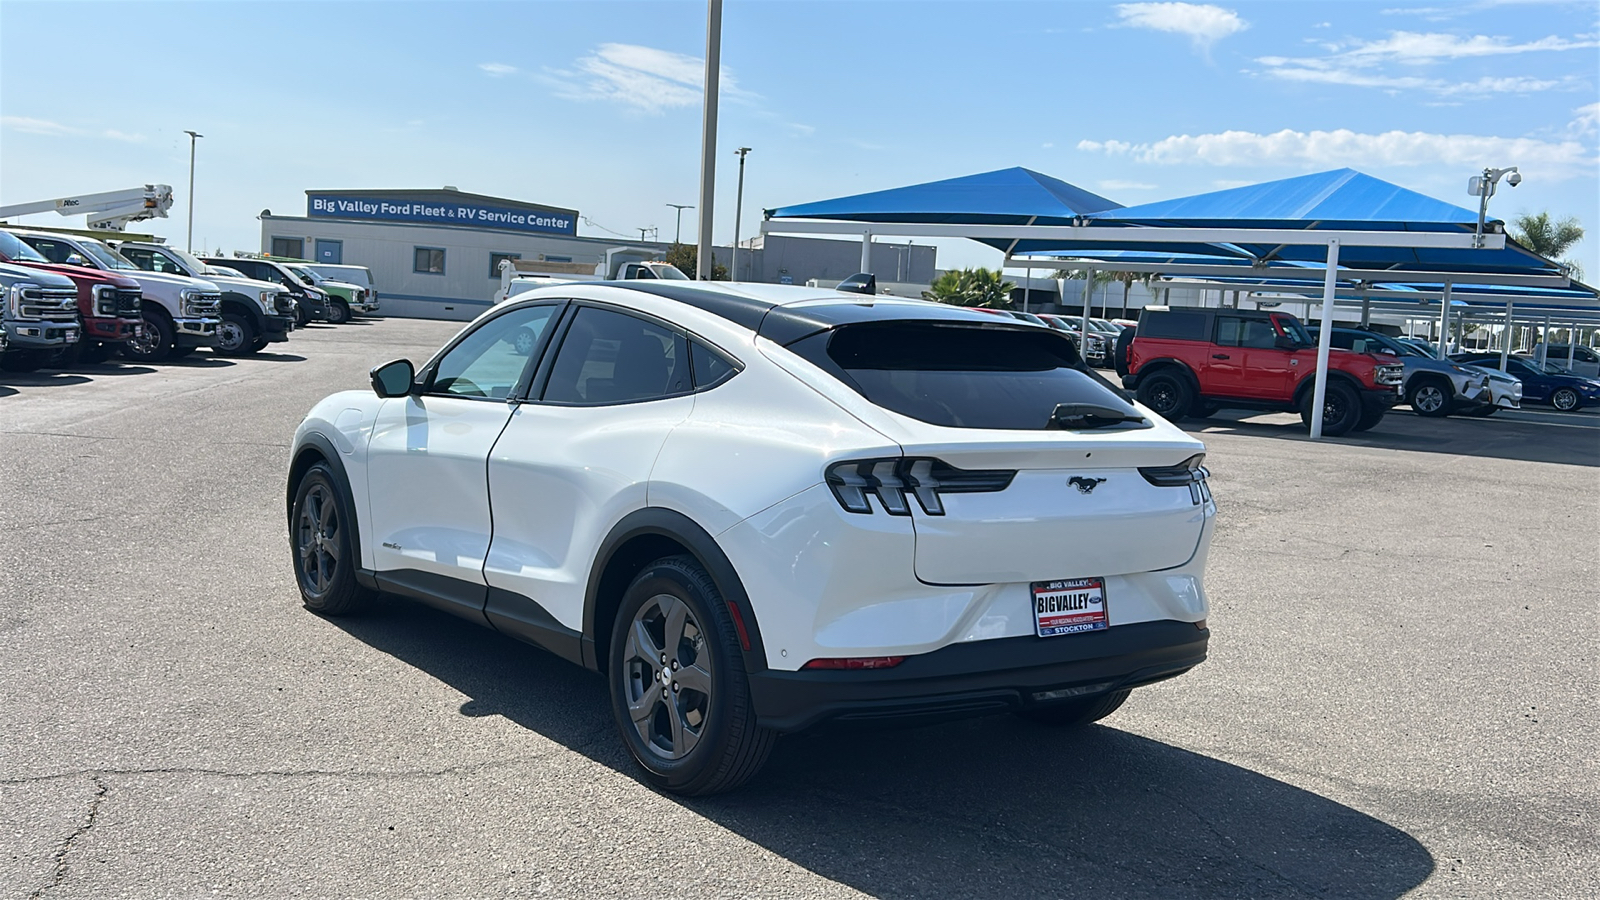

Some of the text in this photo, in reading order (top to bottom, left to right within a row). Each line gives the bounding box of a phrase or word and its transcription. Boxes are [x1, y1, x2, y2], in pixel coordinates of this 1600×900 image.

[313, 199, 569, 229] Big Valley Ford Fleet & RV Service Center
[1064, 579, 1088, 588] VALLEY
[1038, 593, 1089, 613] BIGVALLEY
[1055, 624, 1093, 633] STOCKTON
